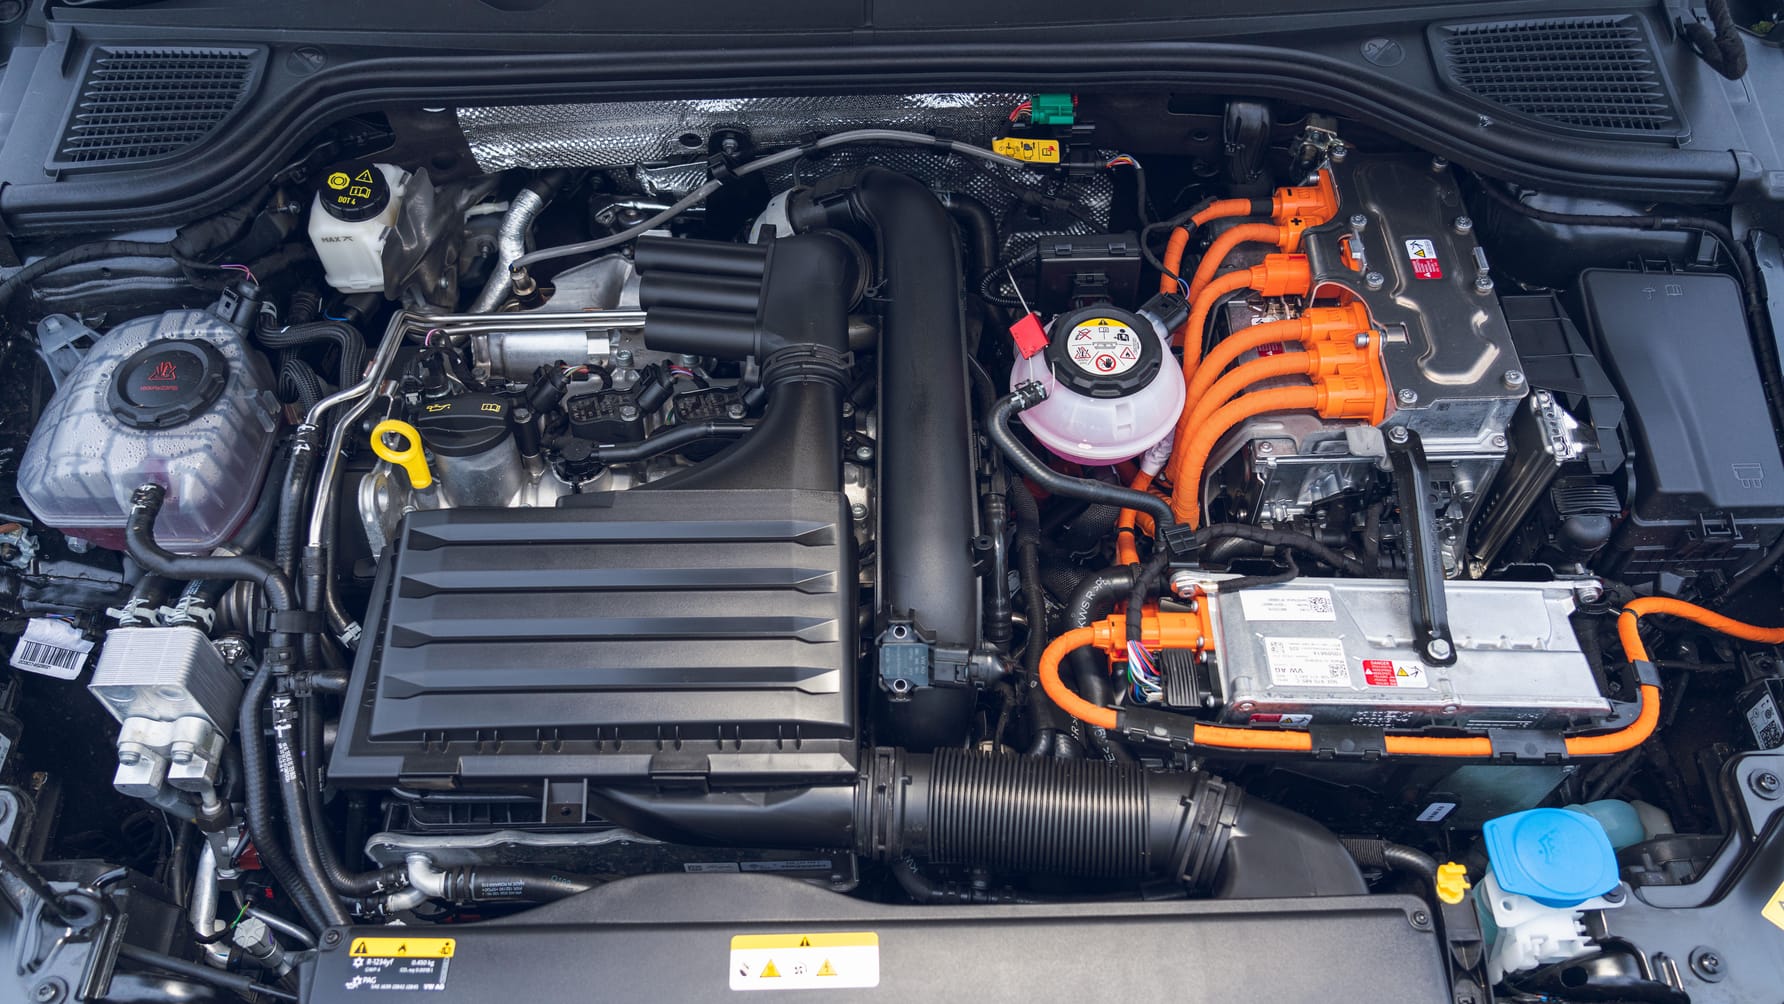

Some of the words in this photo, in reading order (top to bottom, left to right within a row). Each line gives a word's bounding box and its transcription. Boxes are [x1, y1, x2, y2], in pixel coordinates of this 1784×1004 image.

[338, 196, 351, 204] DOT
[321, 235, 341, 243] MAX
[1077, 600, 1090, 628] KWS
[362, 976, 377, 984] PAG
